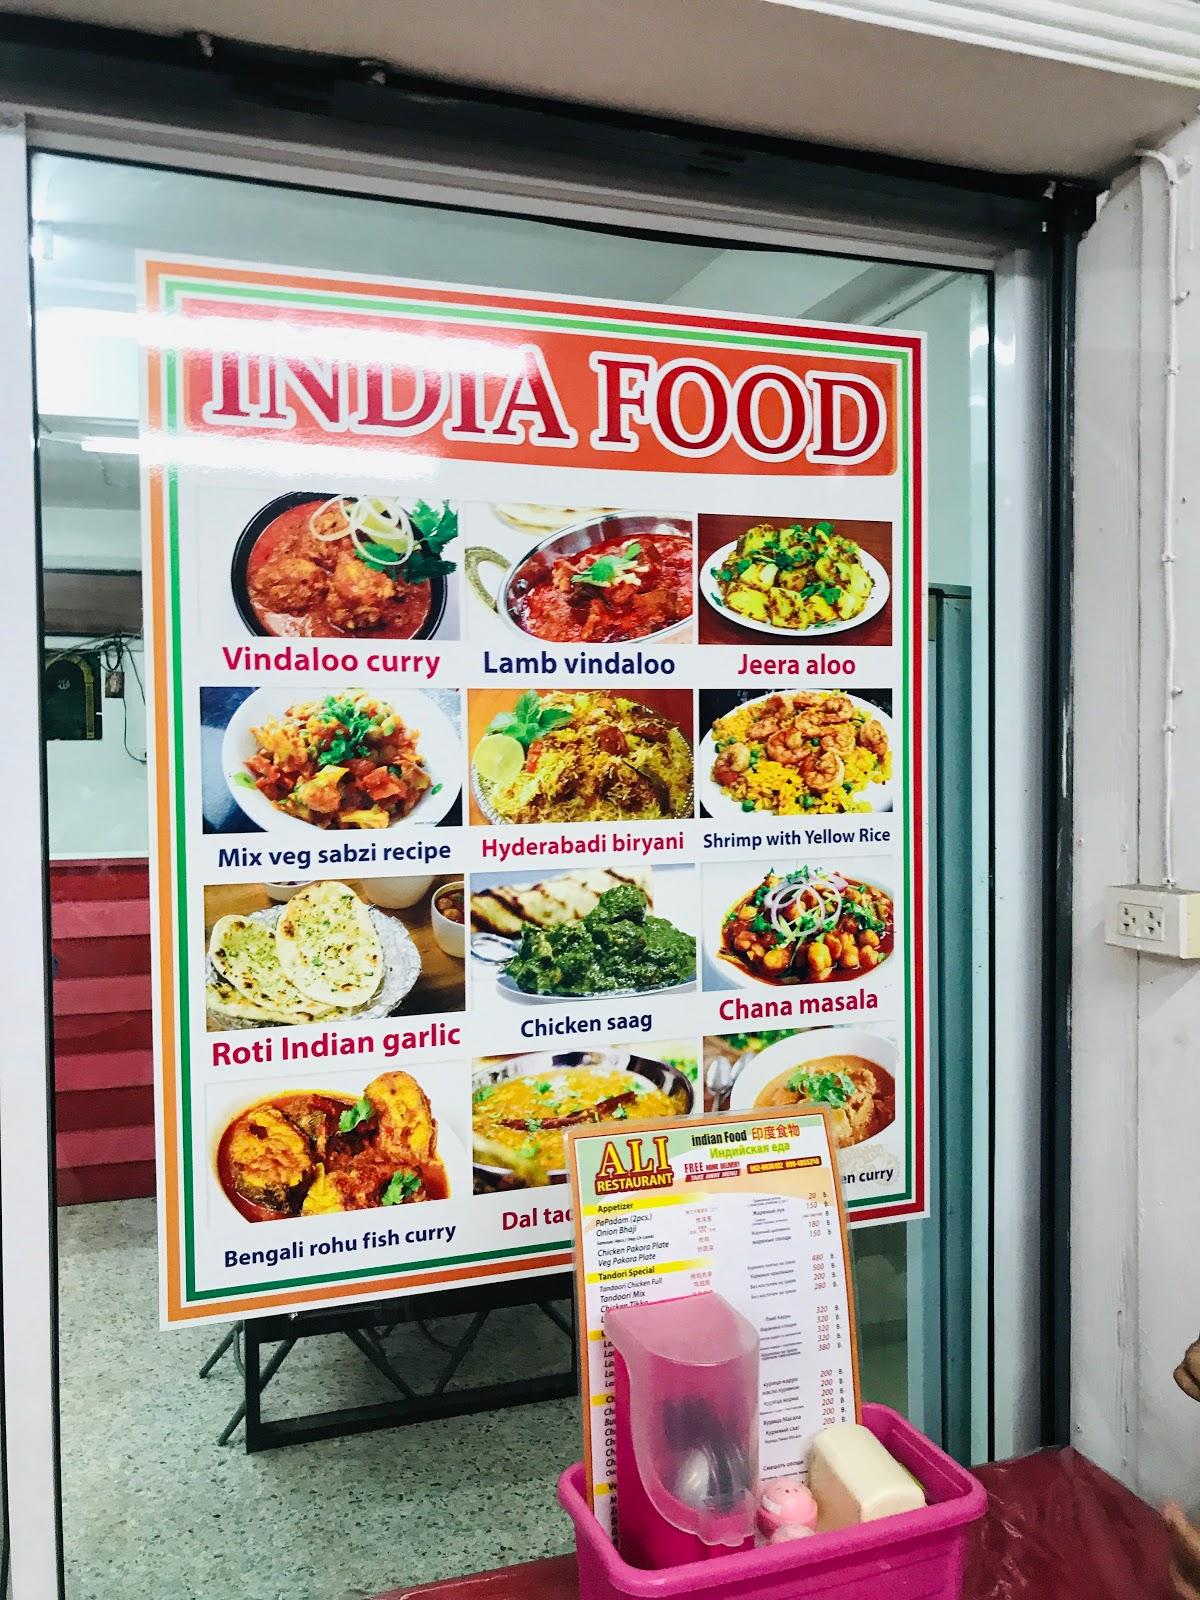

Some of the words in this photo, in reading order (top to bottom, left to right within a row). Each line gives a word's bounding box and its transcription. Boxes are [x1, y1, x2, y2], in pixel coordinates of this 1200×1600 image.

[205, 344, 576, 447] INDIA
[591, 350, 888, 465] FOOD
[223, 646, 357, 673] Vindaloo
[367, 653, 441, 679] curry
[484, 650, 556, 675] Lamb
[564, 652, 675, 675] vindaloo
[737, 653, 800, 675] Jeera
[806, 654, 856, 675] aloo
[482, 833, 607, 862] Hyderabadi
[613, 831, 684, 855] biryani
[703, 832, 762, 850] Shrimp
[766, 830, 801, 847] with
[804, 829, 855, 845] Yellow
[859, 827, 891, 843] Rice
[218, 847, 262, 868] Mix
[268, 848, 311, 870] veg
[318, 843, 377, 863] sabzi
[384, 841, 451, 863] recipe
[719, 995, 793, 1021] Chana
[799, 989, 878, 1014] masala
[520, 1016, 601, 1038] Chicken
[607, 1012, 652, 1033] saag
[212, 1038, 273, 1066] Roti
[282, 1031, 374, 1061] Indian
[383, 1022, 461, 1057] garlic
[691, 1133, 722, 1147] indian
[725, 1129, 747, 1143] Food
[752, 1123, 800, 1140] 印度食物
[597, 1135, 672, 1179] ALI
[710, 1143, 769, 1159] Индийская
[772, 1141, 791, 1154] еда
[684, 1161, 704, 1173] FREE
[859, 1168, 894, 1182] curry
[597, 1172, 674, 1193] RESTAURANT
[598, 1202, 634, 1213] Appetizer
[502, 1207, 538, 1231] Dal
[595, 1217, 629, 1227] PaPadam
[596, 1228, 618, 1237] Onion
[619, 1225, 637, 1234] Bhaji
[224, 1240, 304, 1268] Bengali
[310, 1236, 358, 1257] rohu
[363, 1230, 399, 1250] fish
[405, 1225, 456, 1243] curry
[597, 1248, 625, 1257] Chicken
[626, 1244, 651, 1254] Pakora
[652, 1241, 670, 1249] Plate
[598, 1258, 611, 1267] Veg
[612, 1255, 637, 1265] Pakora
[638, 1253, 657, 1261] Plate
[598, 1271, 628, 1281] Tandori
[629, 1266, 655, 1277] Special
[627, 1280, 651, 1289] Chicken
[601, 1292, 632, 1303] Tandoori
[633, 1291, 646, 1299] Mix
